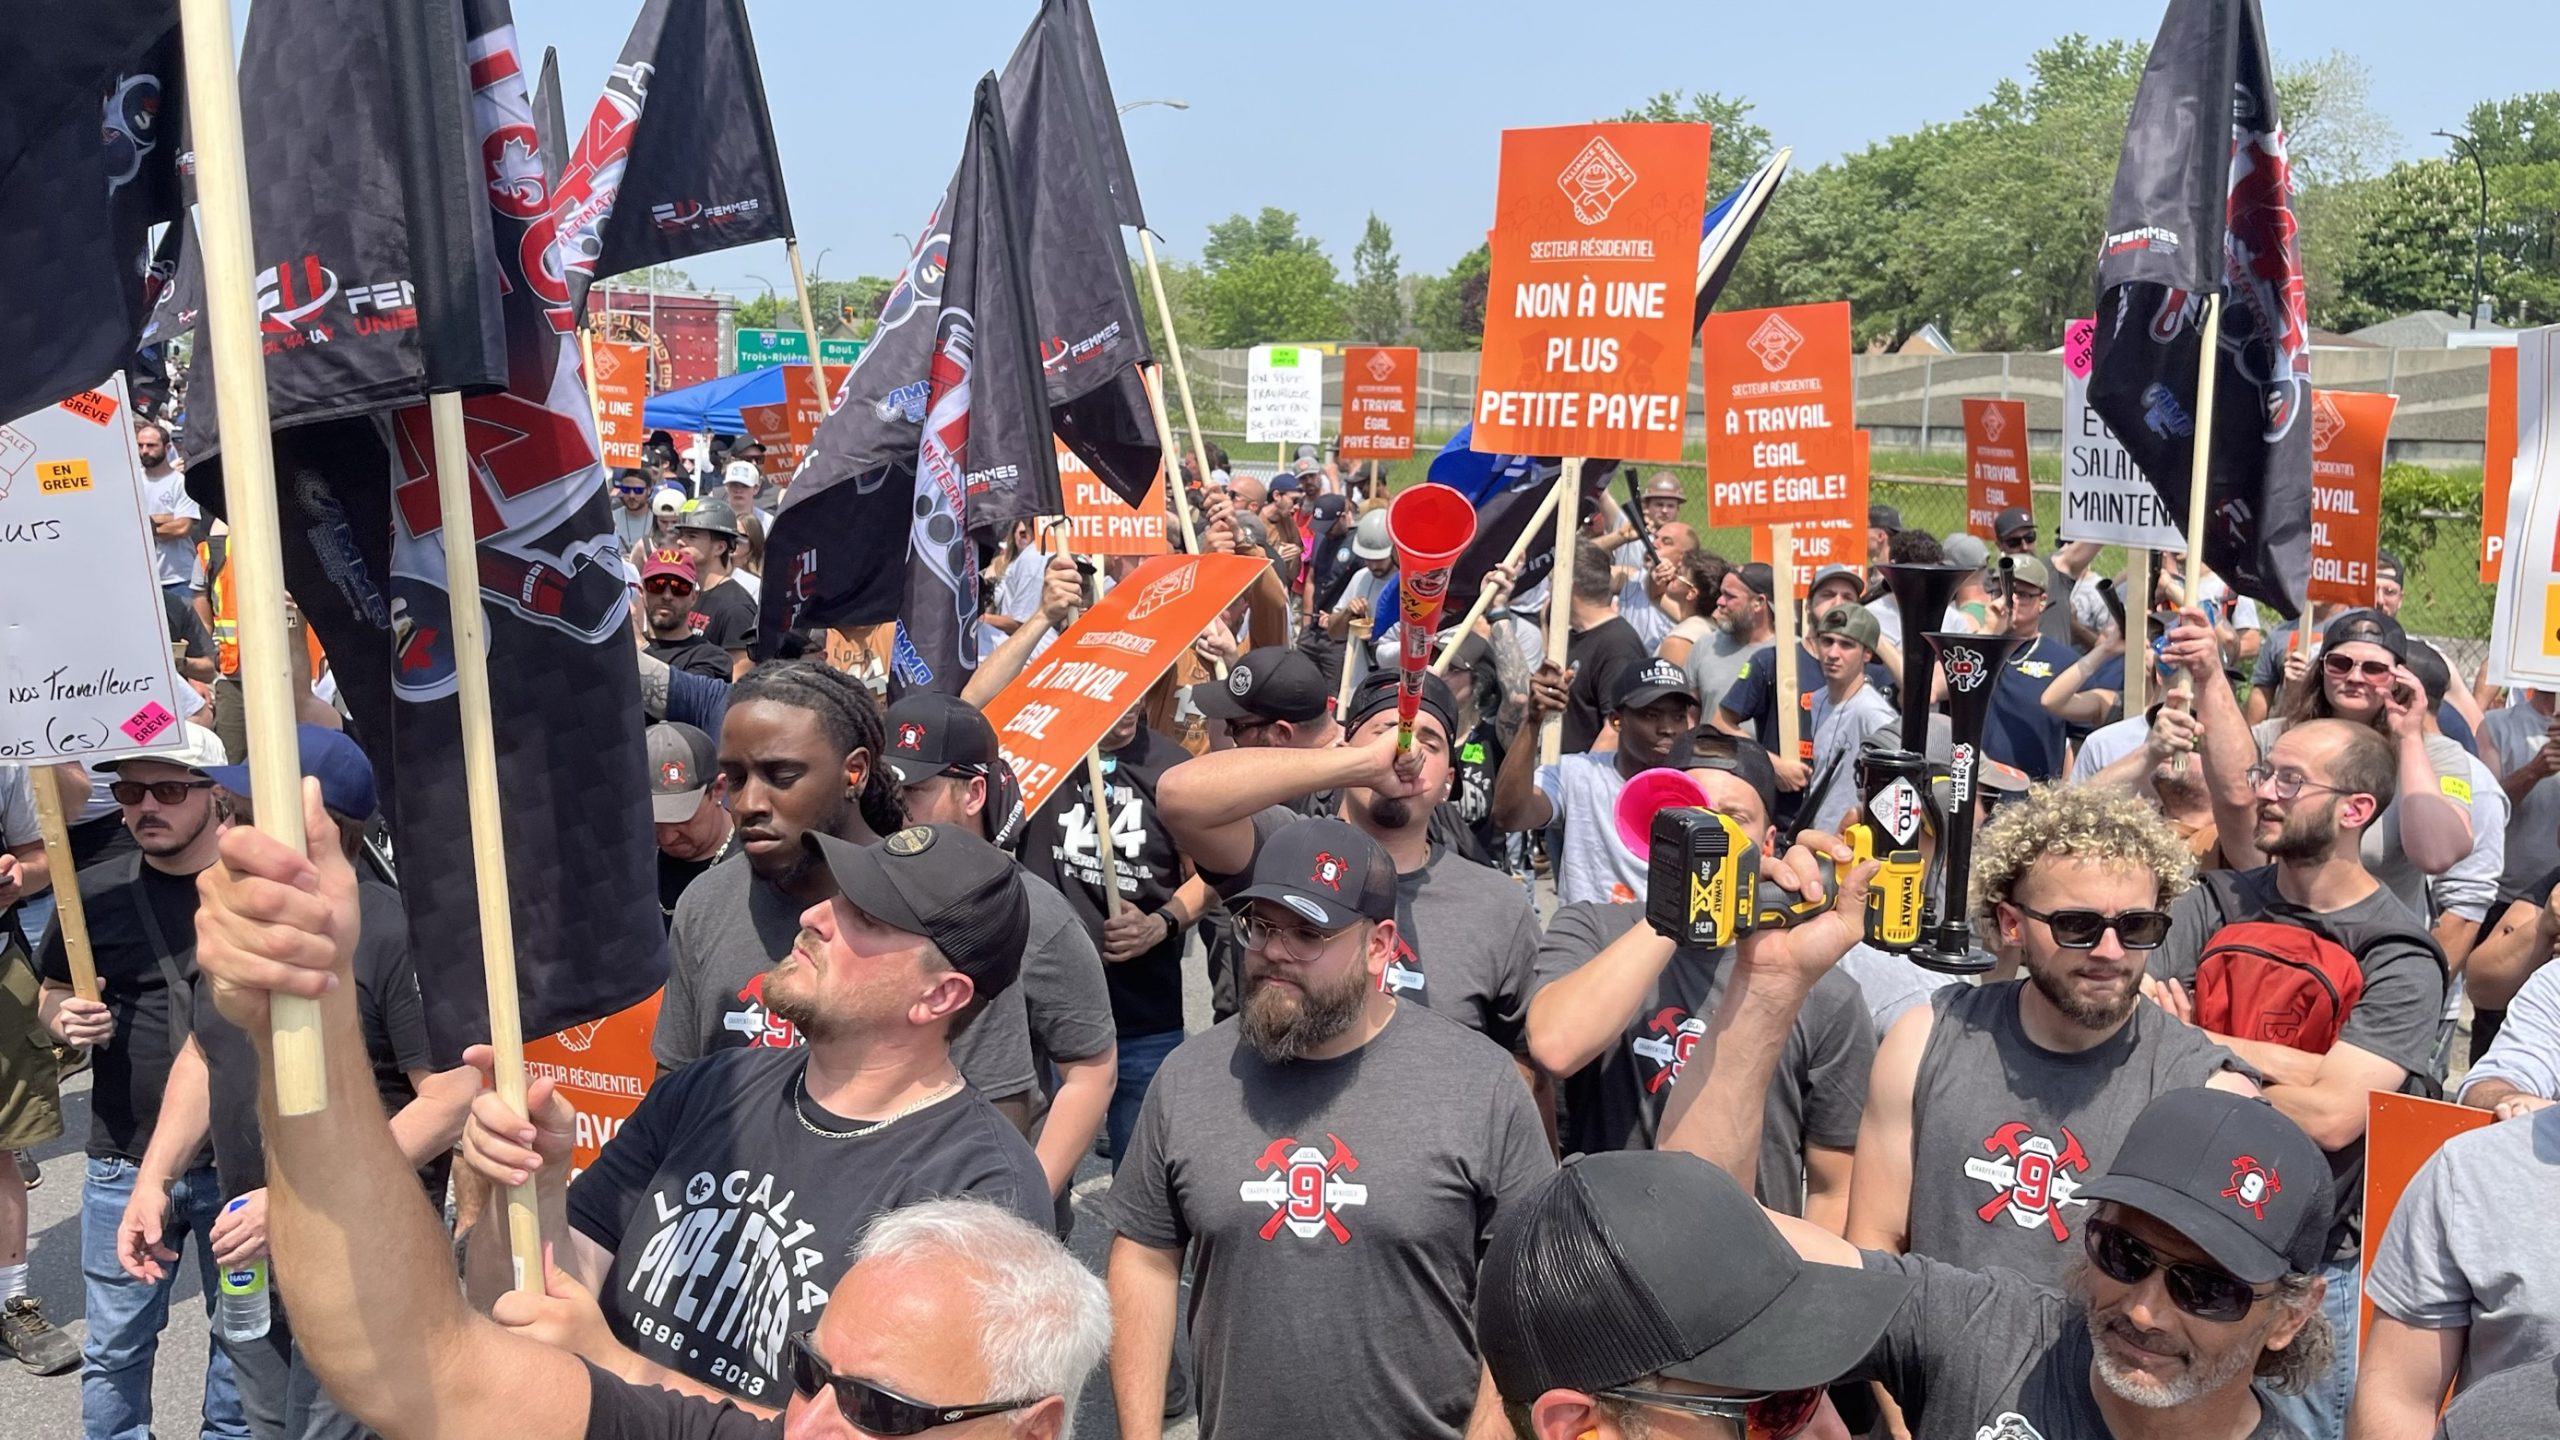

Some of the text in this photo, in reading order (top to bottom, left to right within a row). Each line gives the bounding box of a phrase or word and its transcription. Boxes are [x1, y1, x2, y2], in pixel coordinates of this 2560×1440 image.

[1562, 141, 1631, 186] ALLIANCE SYNDICALE
[705, 198, 758, 218] FEMMES
[1530, 237, 1655, 259] SECTEUR RÉSIDENTIEL
[2109, 226, 2179, 247] FEMMES
[1515, 275, 1666, 319] NON À UNE
[780, 338, 795, 346] EST
[1070, 321, 1120, 357] FEMMES
[2074, 324, 2094, 347] EN
[1546, 338, 1619, 373] PLUS
[82, 390, 102, 406] EN
[1732, 382, 1768, 397] SECTEUR
[64, 398, 110, 424] GRÈVE
[609, 401, 634, 417] UNE
[1362, 397, 1406, 413] TRAVAIL
[1480, 390, 1680, 432] PETITE PAYE!
[1725, 404, 1831, 435] À TRAVAIL
[603, 441, 640, 459] PAYE!
[1343, 435, 1371, 449] PAYE
[1753, 441, 1805, 468] ÉGAL
[52, 464, 72, 477] EN
[967, 464, 1018, 487] EMMES
[1982, 464, 2020, 484] TRAVAIL
[43, 476, 90, 492] GRÈVE
[1077, 484, 1123, 506] PLUS
[1714, 474, 1847, 506] PAYE ÉGALE!
[1108, 515, 1163, 538] PAYE!
[1791, 537, 1831, 557] PLUS
[2308, 556, 2367, 587] GALE!
[9, 665, 154, 704] Nos Travailleurs
[1043, 662, 1128, 702] TRAVAIL
[131, 711, 150, 727] EN
[134, 712, 170, 742] GRÈVE
[1322, 861, 1337, 881] 9
[1700, 922, 1713, 934] 5
[523, 1061, 647, 1096] ECTEUR RÉSIDENTIEL
[2031, 1140, 2050, 1151] LOCAL
[1289, 1163, 1325, 1222] 9
[2013, 1152, 2054, 1213] 9
[2240, 1172, 2263, 1204] 9
[653, 1170, 829, 1314] LOCAL 144
[632, 1312, 685, 1351] 1898
